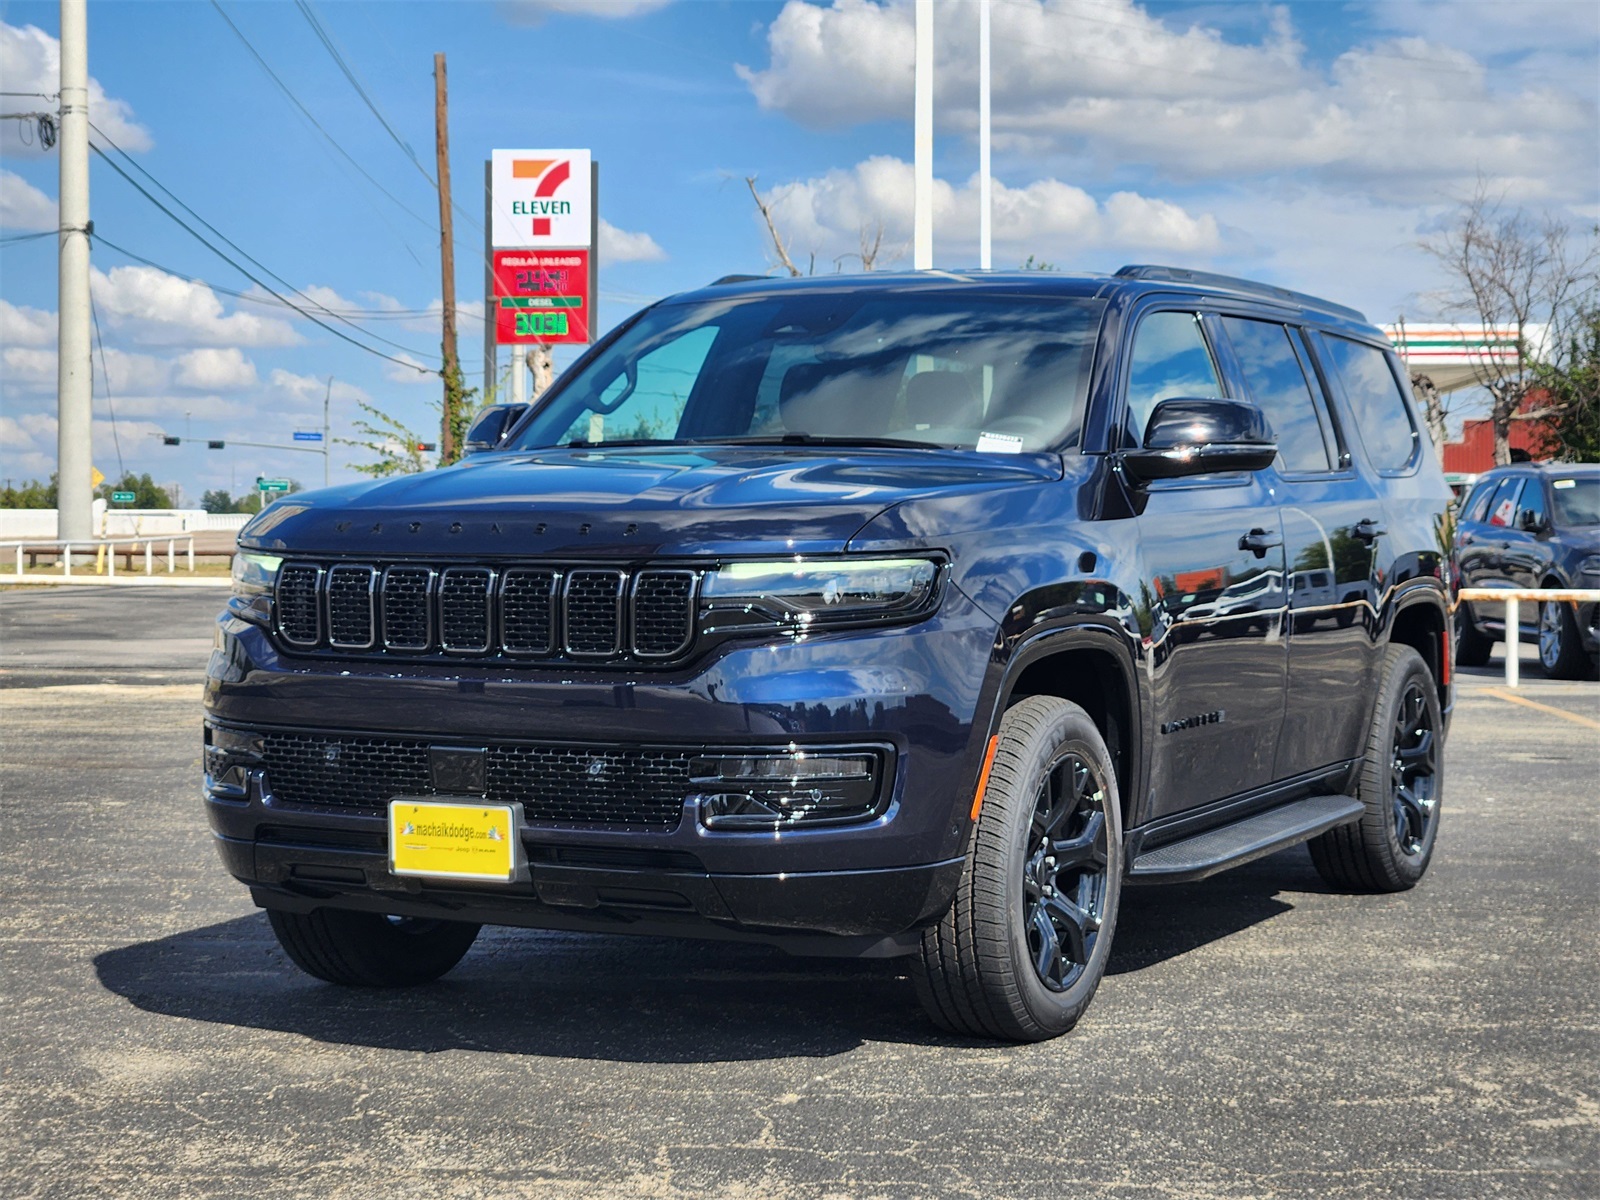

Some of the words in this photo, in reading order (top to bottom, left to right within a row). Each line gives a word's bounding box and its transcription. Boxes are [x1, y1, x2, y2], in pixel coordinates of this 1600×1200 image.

[501, 256, 539, 267] REGULAR
[539, 256, 582, 267] UNLEADED
[527, 297, 555, 307] DIESEL
